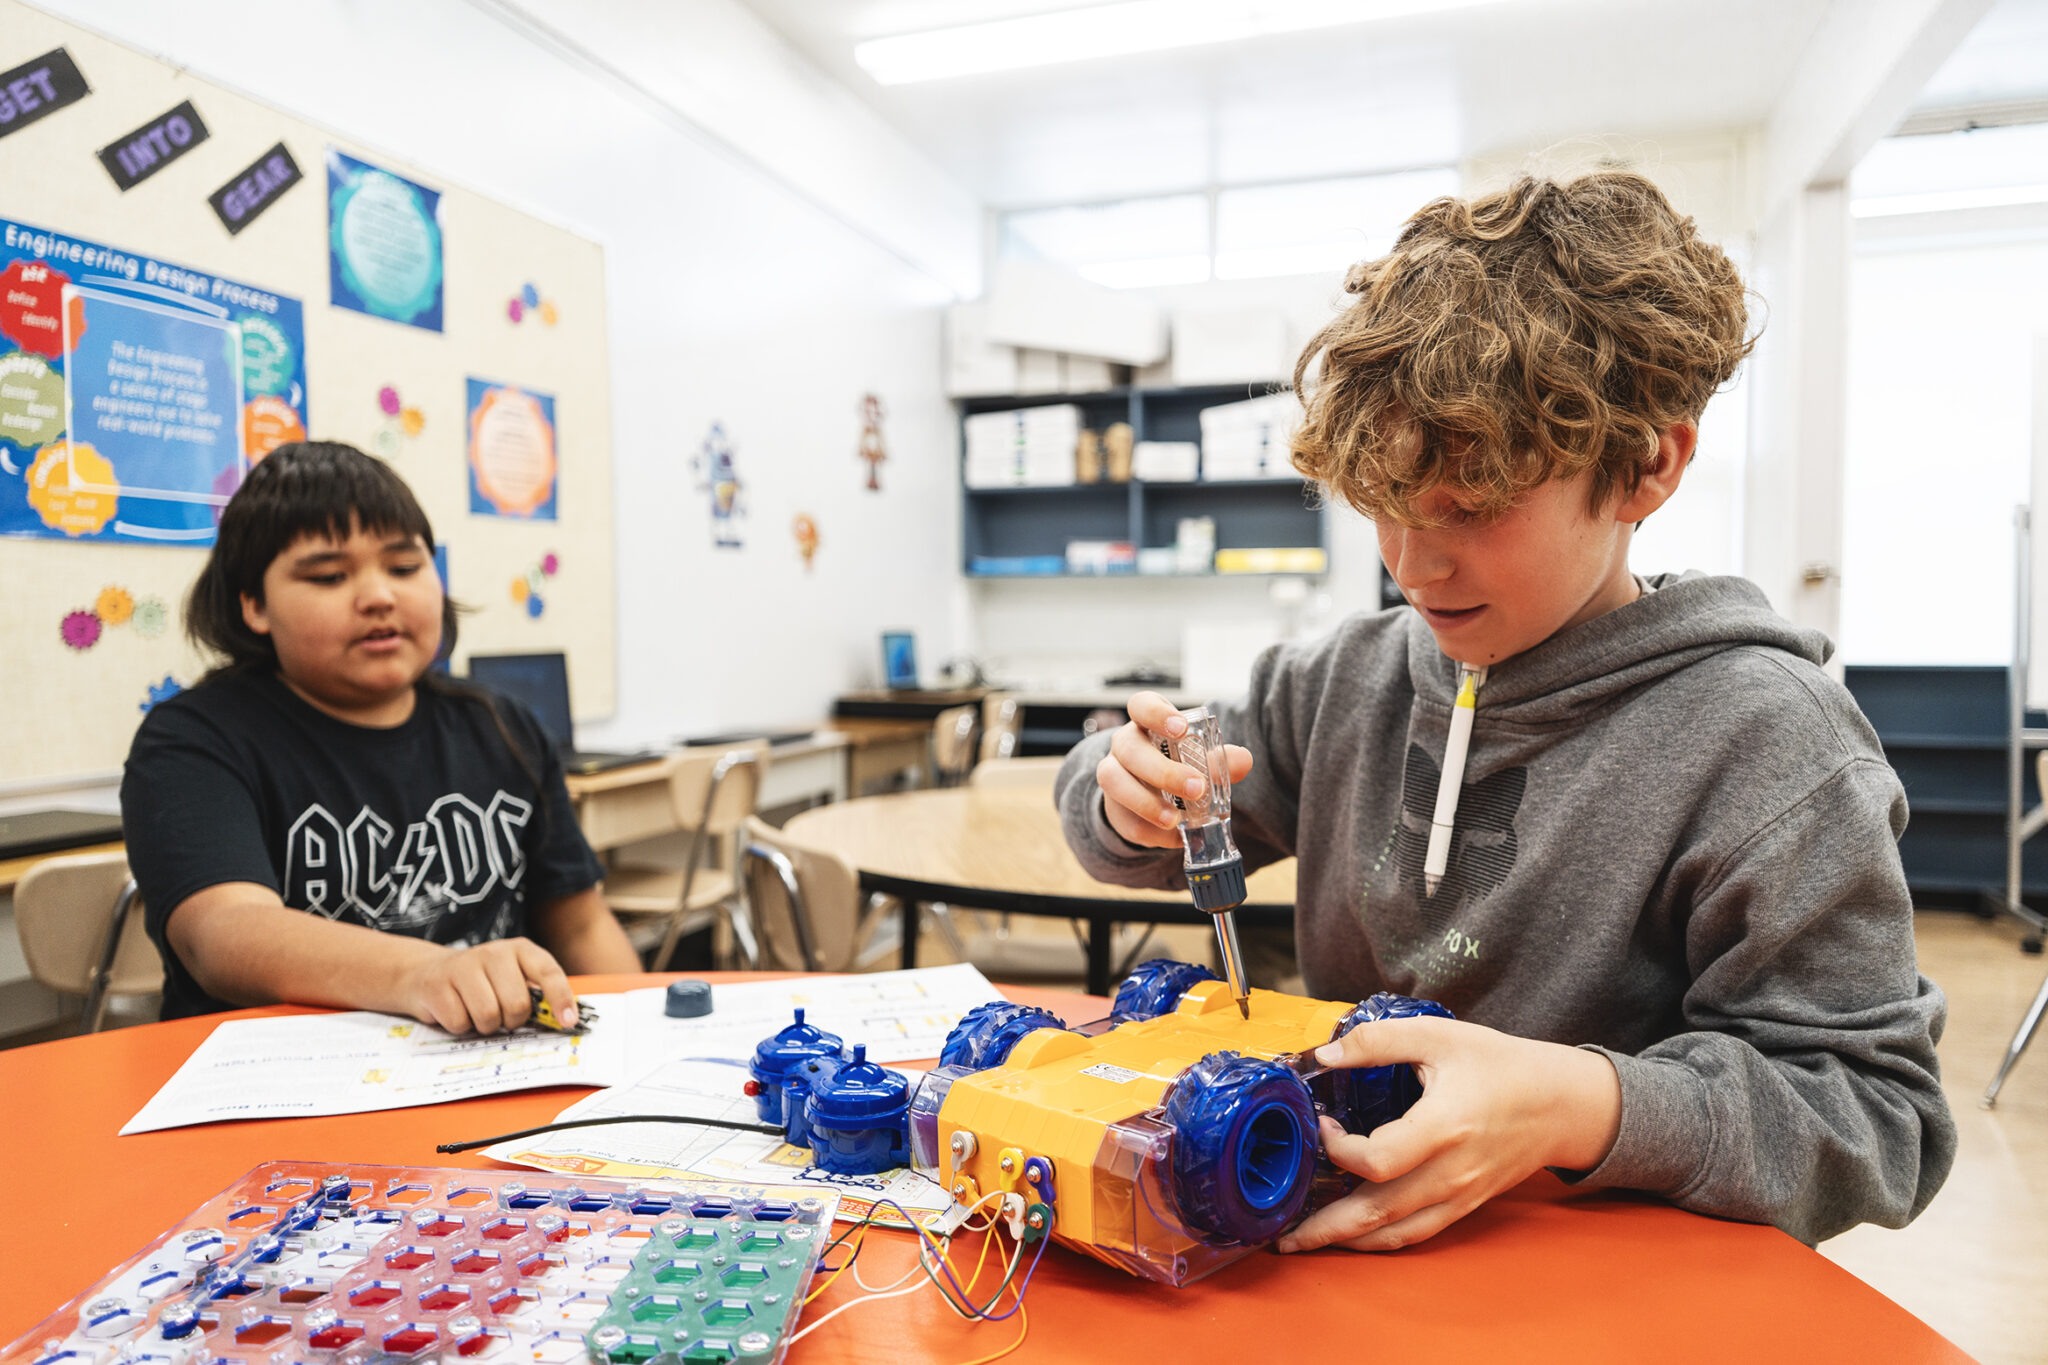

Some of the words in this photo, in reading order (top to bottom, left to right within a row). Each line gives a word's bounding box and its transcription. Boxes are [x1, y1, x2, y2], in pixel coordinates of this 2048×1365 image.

[0, 67, 57, 124] GET
[116, 114, 193, 178] INTO
[222, 155, 293, 222] GEAR
[5, 224, 140, 281] Engineering
[145, 260, 210, 296] Design
[211, 278, 280, 314] Process
